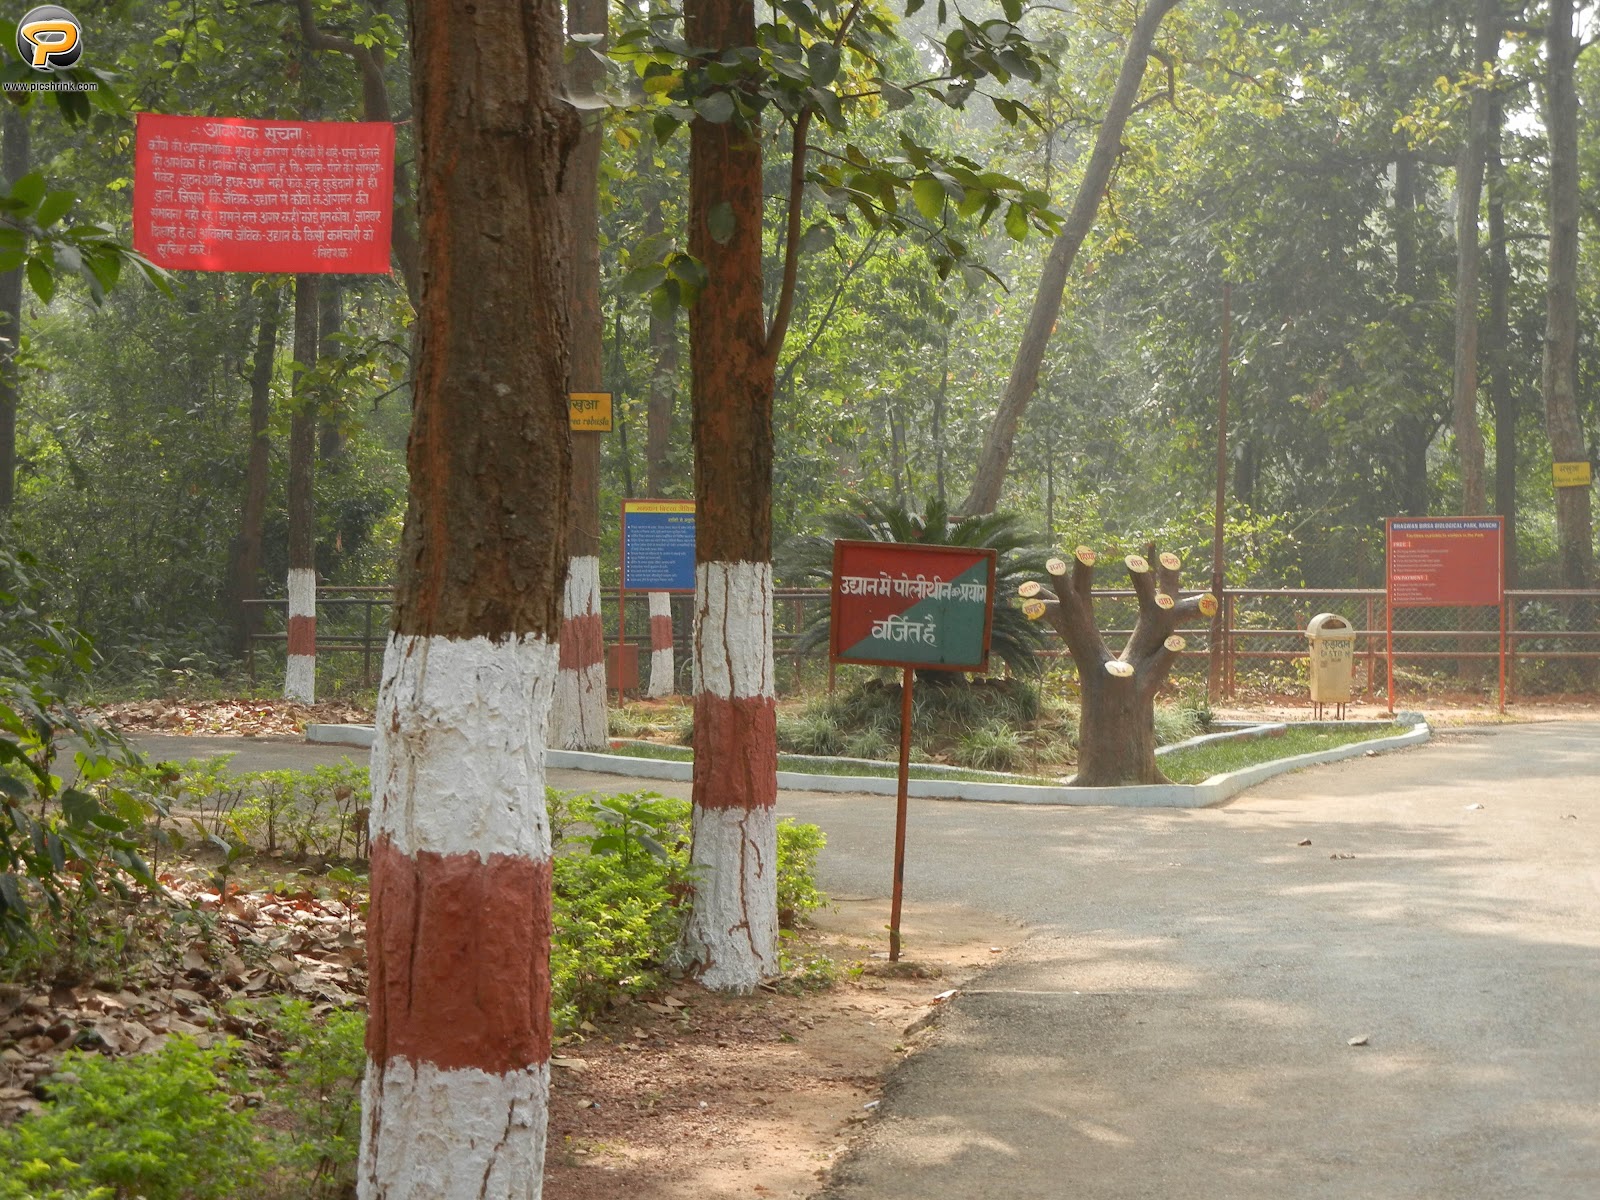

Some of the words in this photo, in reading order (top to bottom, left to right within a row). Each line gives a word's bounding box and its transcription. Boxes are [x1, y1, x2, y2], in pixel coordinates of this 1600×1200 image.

[203, 123, 258, 139] आवश्यक
[264, 127, 302, 144] सूचना
[263, 146, 289, 158] कारण
[239, 159, 247, 172] से
[202, 172, 223, 187] आदि
[356, 190, 369, 205] की
[260, 211, 280, 224] अगर
[292, 226, 302, 240] के
[304, 225, 326, 242] किसी
[327, 224, 361, 242] कर्मचारी
[363, 225, 374, 240] को
[569, 399, 600, 414] खुआ
[840, 575, 879, 597] उद्यान
[878, 571, 892, 598] में
[893, 572, 953, 601] पोलीथीन
[960, 578, 986, 603] प्रयोग
[871, 614, 924, 644] वर्जित
[922, 614, 938, 648] है
